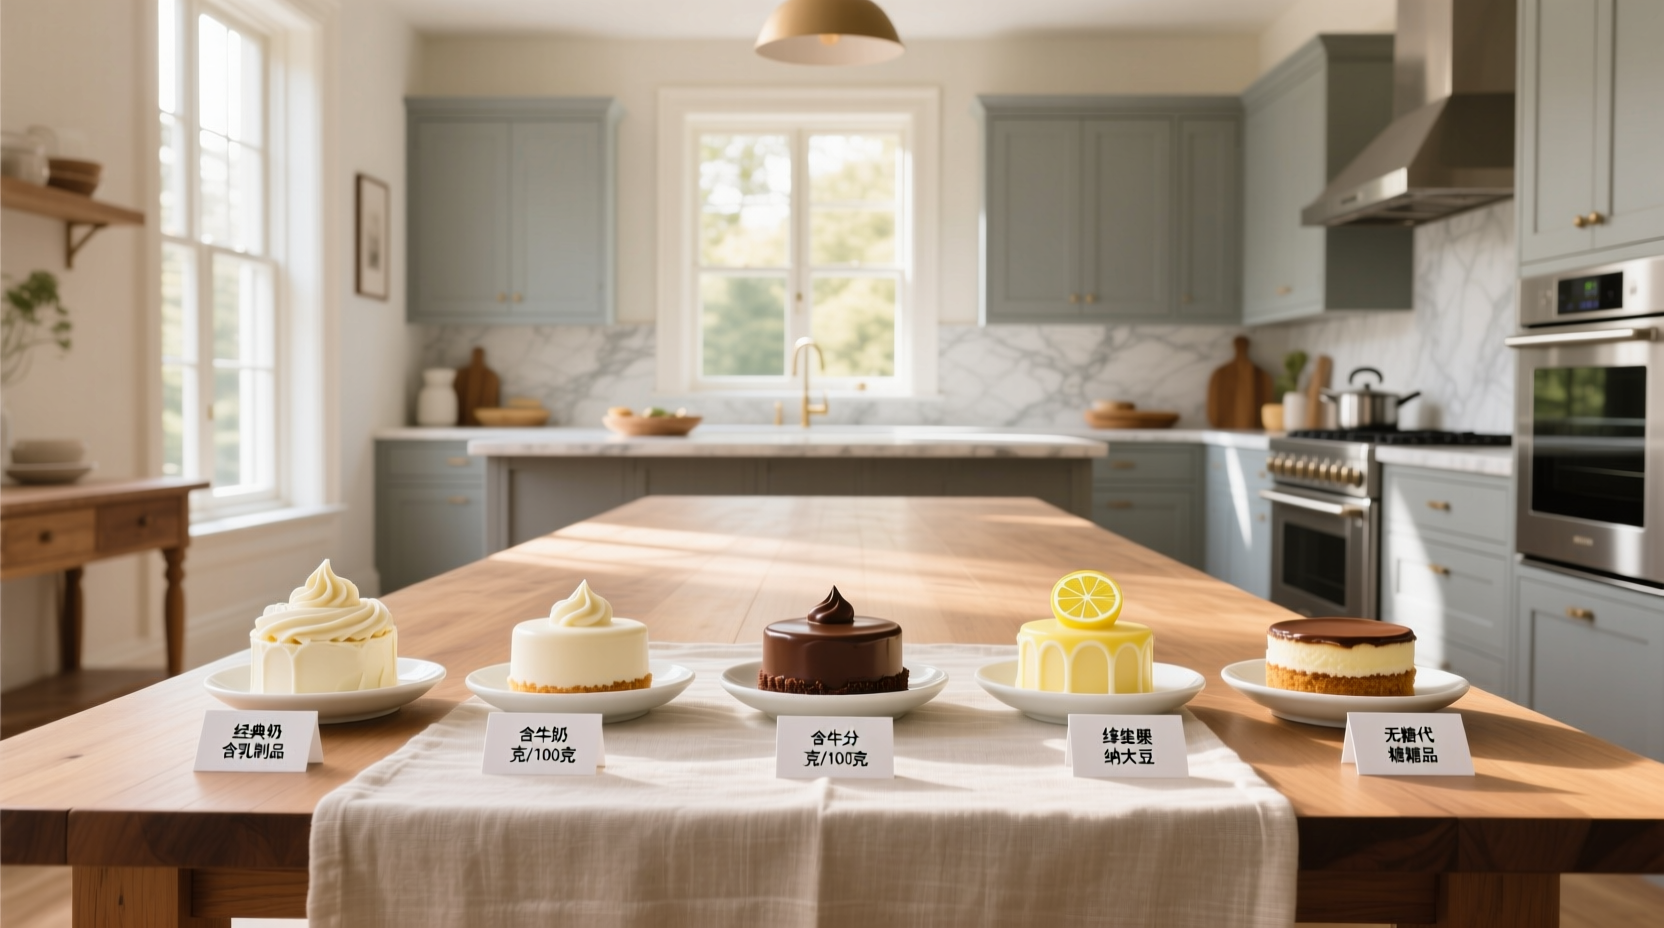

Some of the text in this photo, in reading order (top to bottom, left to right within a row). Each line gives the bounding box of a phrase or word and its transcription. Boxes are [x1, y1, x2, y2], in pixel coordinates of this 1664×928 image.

[1384, 726, 1435, 743] 无糖代
[222, 742, 285, 760] 含乳制品
[510, 745, 577, 763] 克/100克
[1104, 747, 1155, 765] 纳大豆
